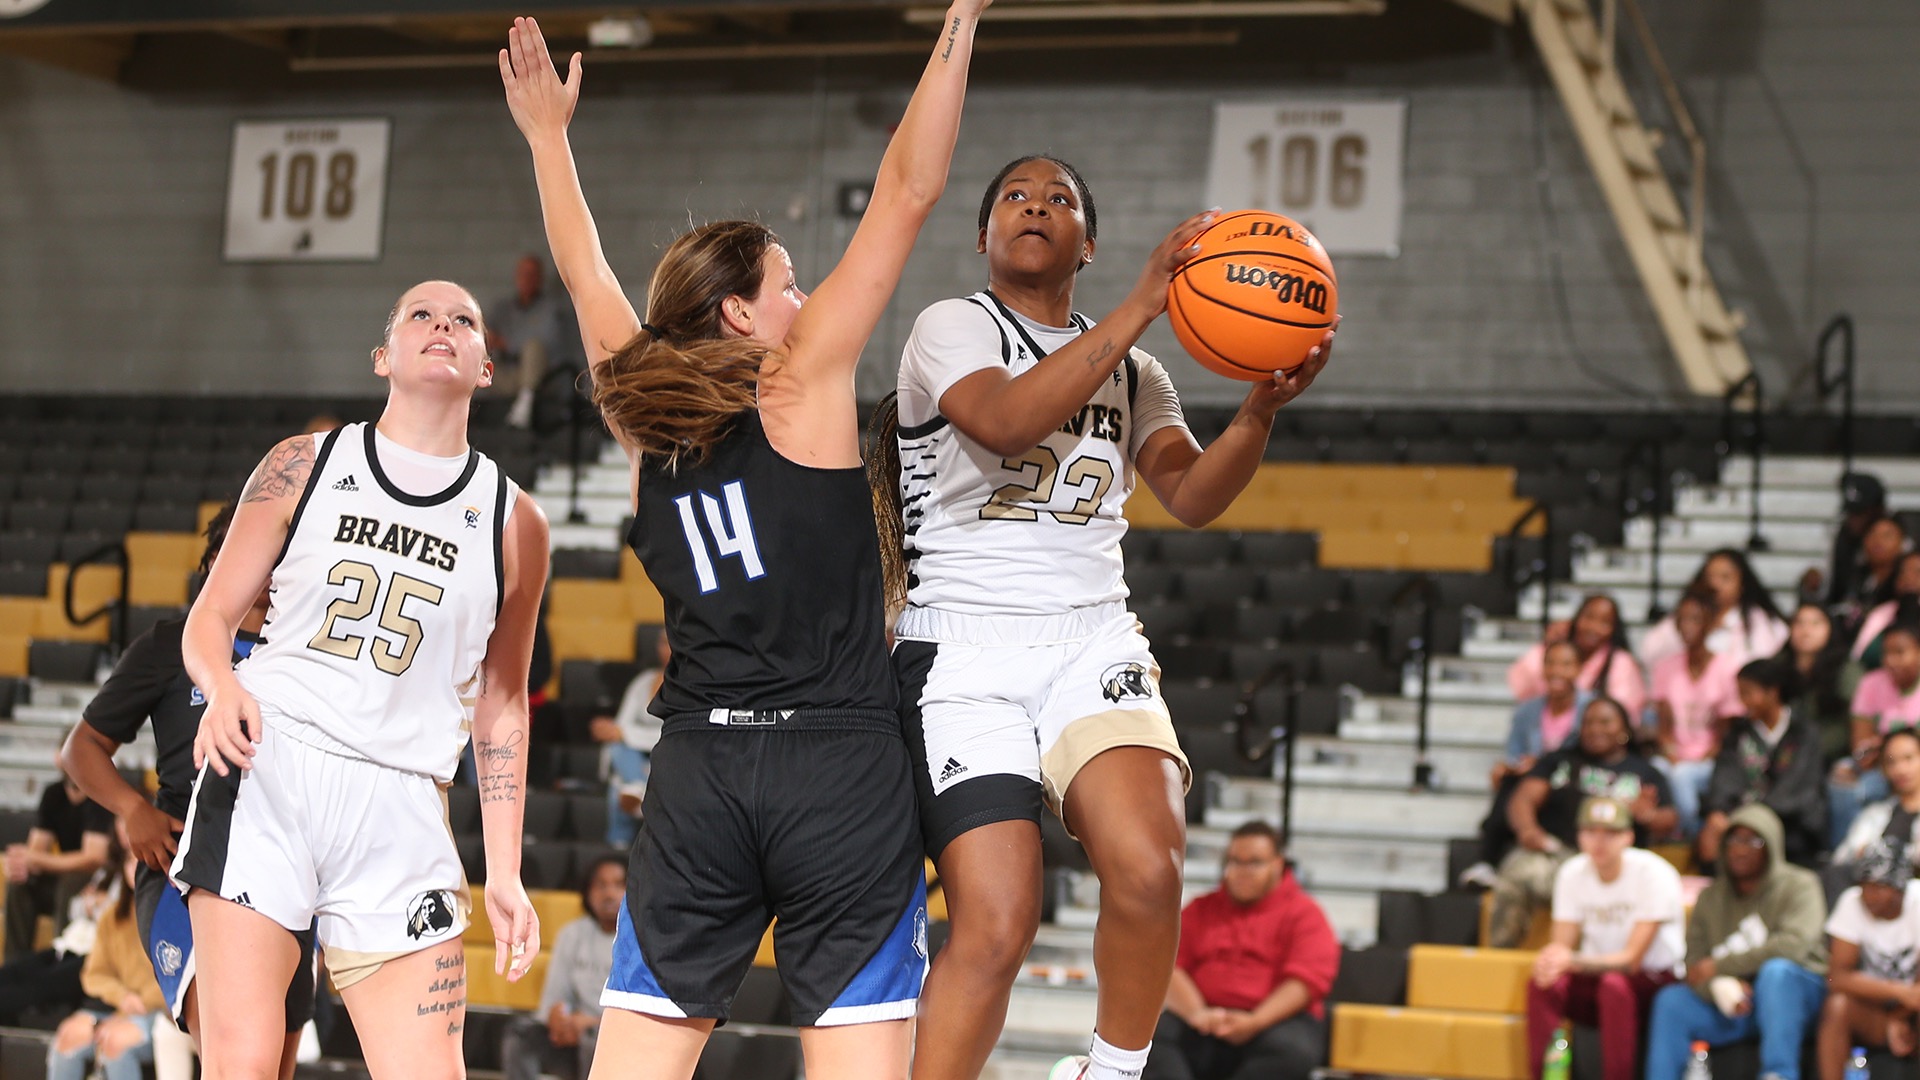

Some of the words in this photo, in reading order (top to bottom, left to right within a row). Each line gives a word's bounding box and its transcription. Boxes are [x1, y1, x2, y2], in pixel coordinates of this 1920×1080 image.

[258, 152, 357, 220] 108
[1247, 133, 1367, 211] 106
[1249, 221, 1313, 247] EVO
[1226, 262, 1328, 315] Wilson
[1057, 404, 1122, 443] VES
[331, 483, 360, 492] adidas
[978, 445, 1115, 526] 23
[333, 514, 459, 573] BRAVES
[671, 478, 768, 595] 14
[307, 559, 445, 677] 25
[938, 765, 969, 784] adidas
